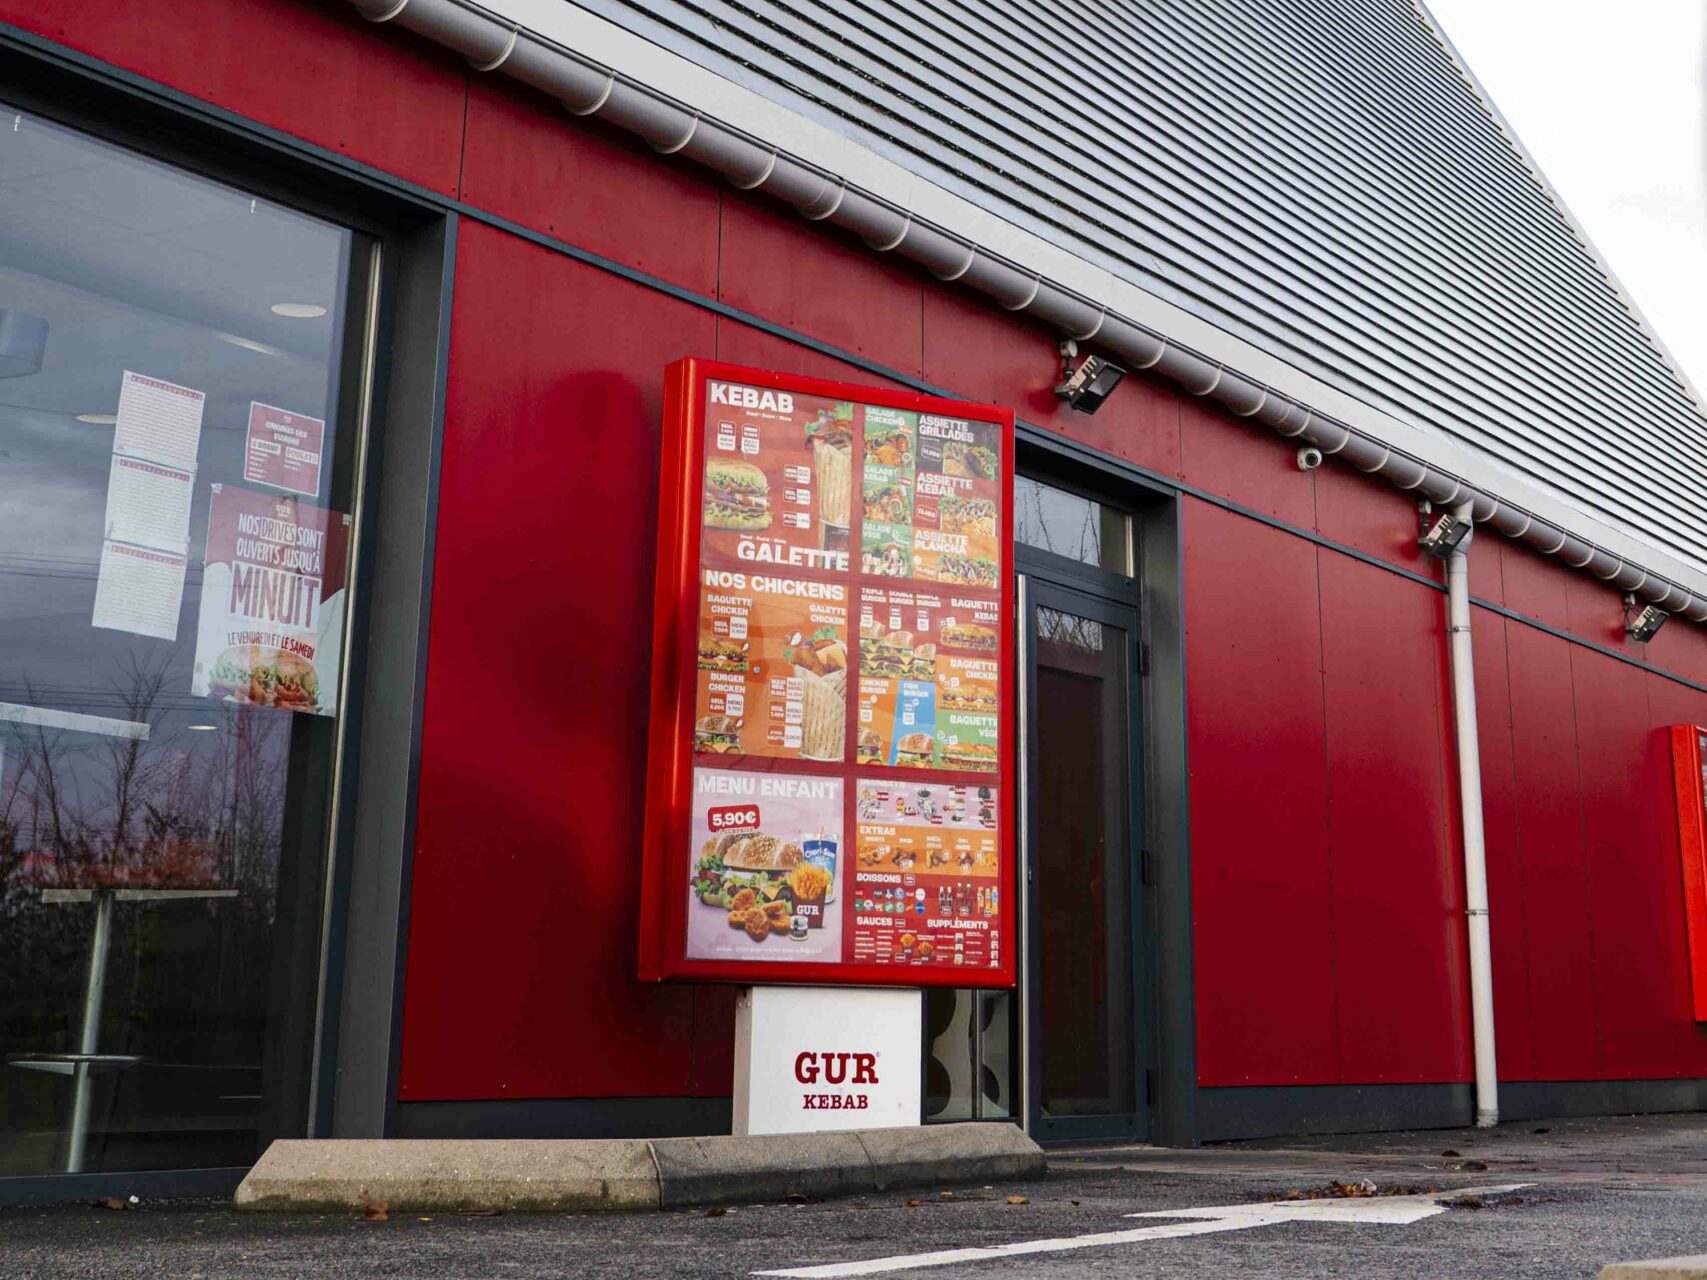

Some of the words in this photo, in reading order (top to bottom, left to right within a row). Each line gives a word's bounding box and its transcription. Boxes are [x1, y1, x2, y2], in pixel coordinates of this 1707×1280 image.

[711, 382, 794, 413] KEBAB
[919, 415, 968, 432] ASSIETTE
[919, 425, 974, 443] GRILLADES
[917, 473, 973, 490] ASSIETTE
[916, 482, 955, 497] KEBAB
[238, 513, 261, 536] NOS
[261, 518, 295, 544] DRIVES
[297, 526, 324, 550] SONT
[915, 530, 968, 546] ASSIETTE
[915, 540, 966, 554] PLANCHA
[236, 537, 280, 565] OUVERTS
[281, 548, 320, 574] JUSQU'À
[737, 540, 849, 571] GALETTE
[706, 570, 746, 590] NOS
[751, 576, 844, 601] CHICKENS
[230, 562, 319, 628] MINUIT
[707, 594, 753, 607] BAGUETTE
[711, 605, 749, 616] CHICKEN
[809, 604, 846, 616] GALETTE
[810, 614, 845, 625] CHICKEN
[227, 632, 236, 646] LE
[237, 631, 271, 646] VENDREDI
[272, 634, 280, 647] ET
[281, 635, 290, 650] LE
[290, 639, 314, 661] SAMEDI
[710, 672, 744, 683] BURGER
[708, 683, 746, 694] CHICKEN
[699, 775, 755, 795] MENU
[761, 778, 839, 799] ENFANT
[712, 811, 757, 827] 5,90€
[860, 826, 896, 836] EXTRAS
[857, 873, 901, 883] BOISSONS
[796, 905, 819, 915] GUR
[857, 917, 893, 926] SAUCES
[927, 917, 988, 929] SUPPLÉMENTS
[795, 1051, 879, 1084] GUR
[803, 1094, 868, 1109] KEBAB
